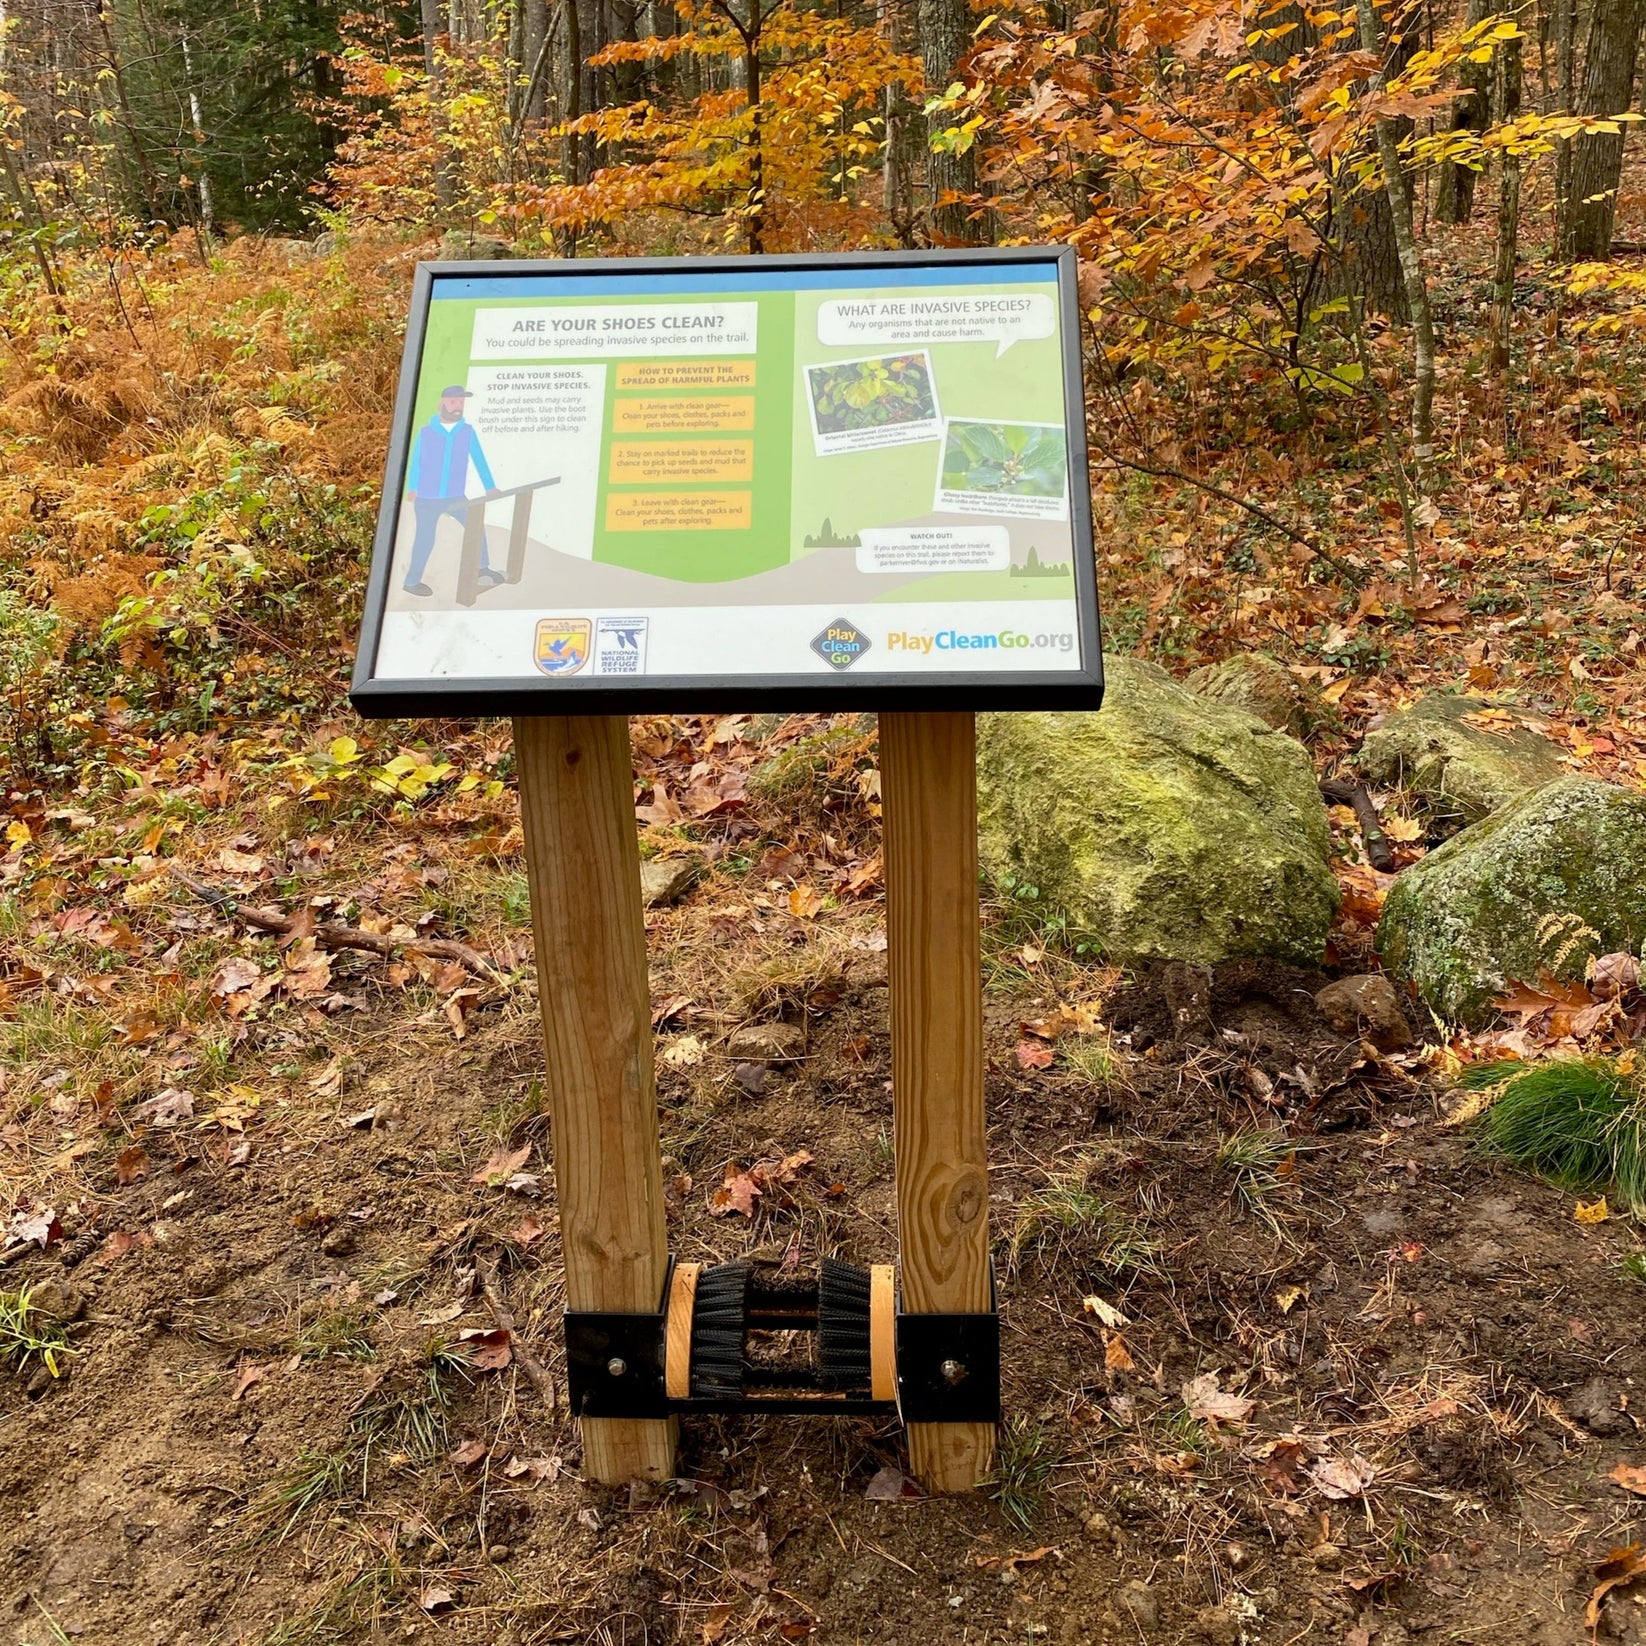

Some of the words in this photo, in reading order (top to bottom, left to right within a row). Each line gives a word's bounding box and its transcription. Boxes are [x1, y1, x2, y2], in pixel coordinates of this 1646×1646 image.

[837, 305, 877, 317] WHAT
[880, 304, 906, 315] ARE
[911, 302, 970, 314] INVASIVE
[975, 300, 1031, 312] SPECIES?
[512, 321, 545, 332] ARE
[551, 319, 596, 331] YOUR
[602, 317, 655, 330] SHOES
[662, 316, 724, 329] CLEAN?
[849, 321, 866, 329] Any
[868, 319, 912, 329] organisms
[915, 319, 933, 327] that
[969, 316, 995, 324] native
[891, 330, 910, 338] area
[913, 328, 929, 337] and
[932, 328, 957, 336] cause
[960, 327, 985, 336] harm.
[486, 339, 505, 347] You
[508, 338, 535, 347] could
[539, 337, 551, 346] be
[554, 336, 603, 348] spreading
[607, 334, 647, 345] invasive
[650, 334, 686, 345] species
[690, 335, 703, 343] on
[707, 332, 723, 342] the
[726, 332, 749, 342] trail.
[540, 416, 555, 424] sign
[643, 413, 657, 421] your
[659, 411, 680, 419] shoes,
[711, 410, 730, 418] packs
[646, 421, 660, 429] pets
[627, 450, 641, 459] Stay
[616, 459, 640, 467] chance
[651, 459, 665, 467] pick
[643, 468, 660, 476] carry
[662, 467, 689, 475] invasive
[692, 467, 718, 475] species.
[637, 509, 652, 517] your
[707, 507, 727, 515] packs
[643, 517, 658, 525] pets
[828, 629, 856, 642] Play
[821, 641, 860, 652] Clean
[888, 631, 1073, 654] PlayCleanGo.org
[831, 653, 850, 664] Go
